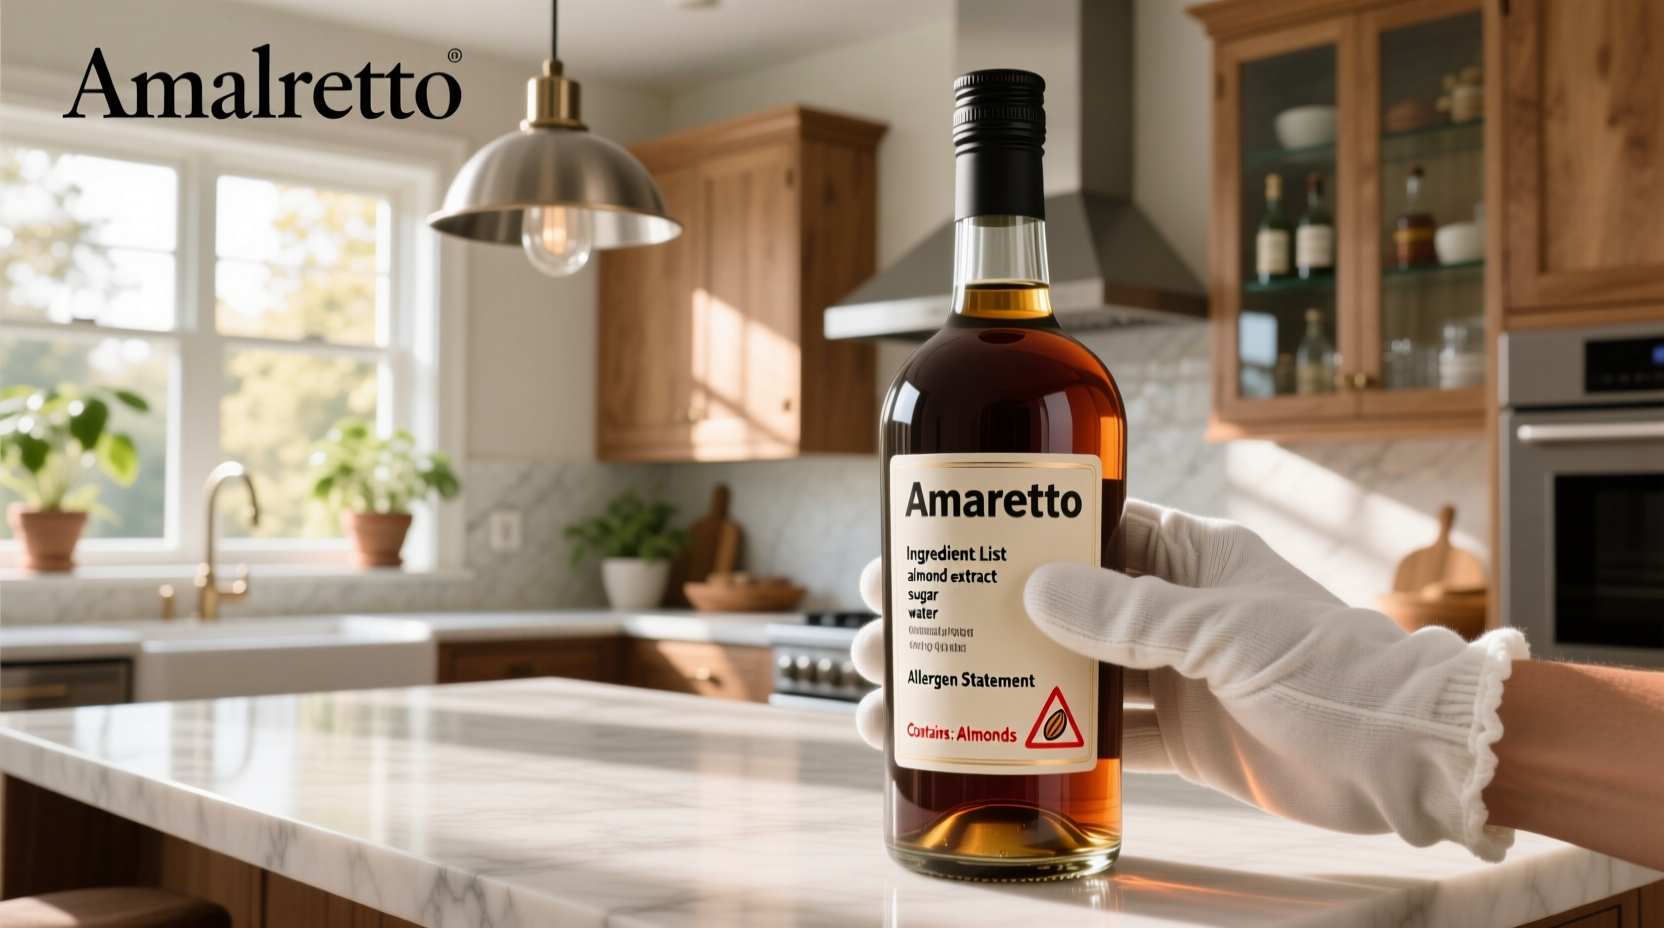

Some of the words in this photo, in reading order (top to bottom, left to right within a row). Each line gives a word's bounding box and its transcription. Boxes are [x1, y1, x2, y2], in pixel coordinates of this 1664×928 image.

[905, 481, 1083, 519] Amaretto
[906, 545, 976, 565] Ingredient
[979, 545, 1007, 562] List
[907, 568, 948, 583] almond
[950, 570, 998, 583] extract
[908, 590, 939, 604] sugar
[908, 608, 939, 620] water
[907, 669, 958, 690] Allergen
[961, 672, 1036, 688] Statement
[956, 725, 1017, 743] Almonds
